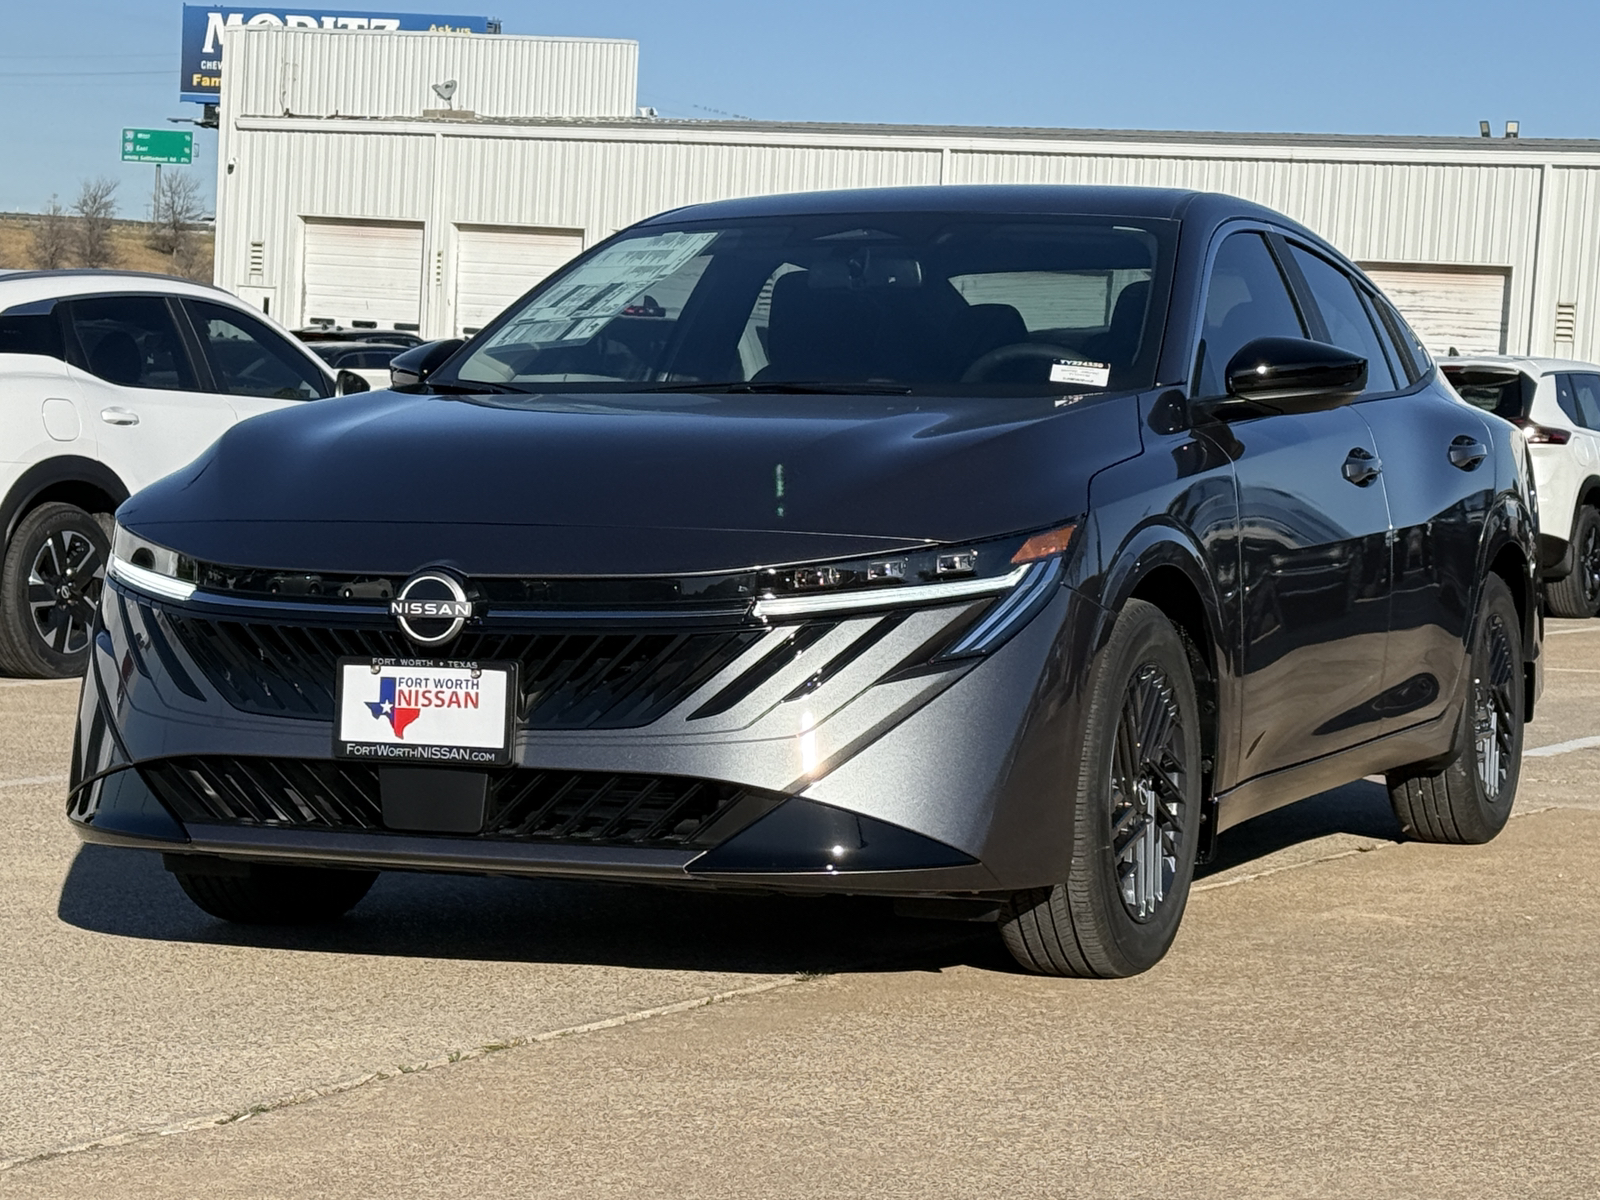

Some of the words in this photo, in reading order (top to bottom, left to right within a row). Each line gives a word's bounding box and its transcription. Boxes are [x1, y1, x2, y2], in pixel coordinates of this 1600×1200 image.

[391, 602, 469, 615] NISSAN
[372, 657, 396, 666] FORT
[400, 659, 434, 667] WORTH
[447, 660, 478, 669] TEXAS
[398, 676, 430, 688] FORT
[433, 678, 479, 690] WORTH
[397, 689, 479, 709] NISSAN
